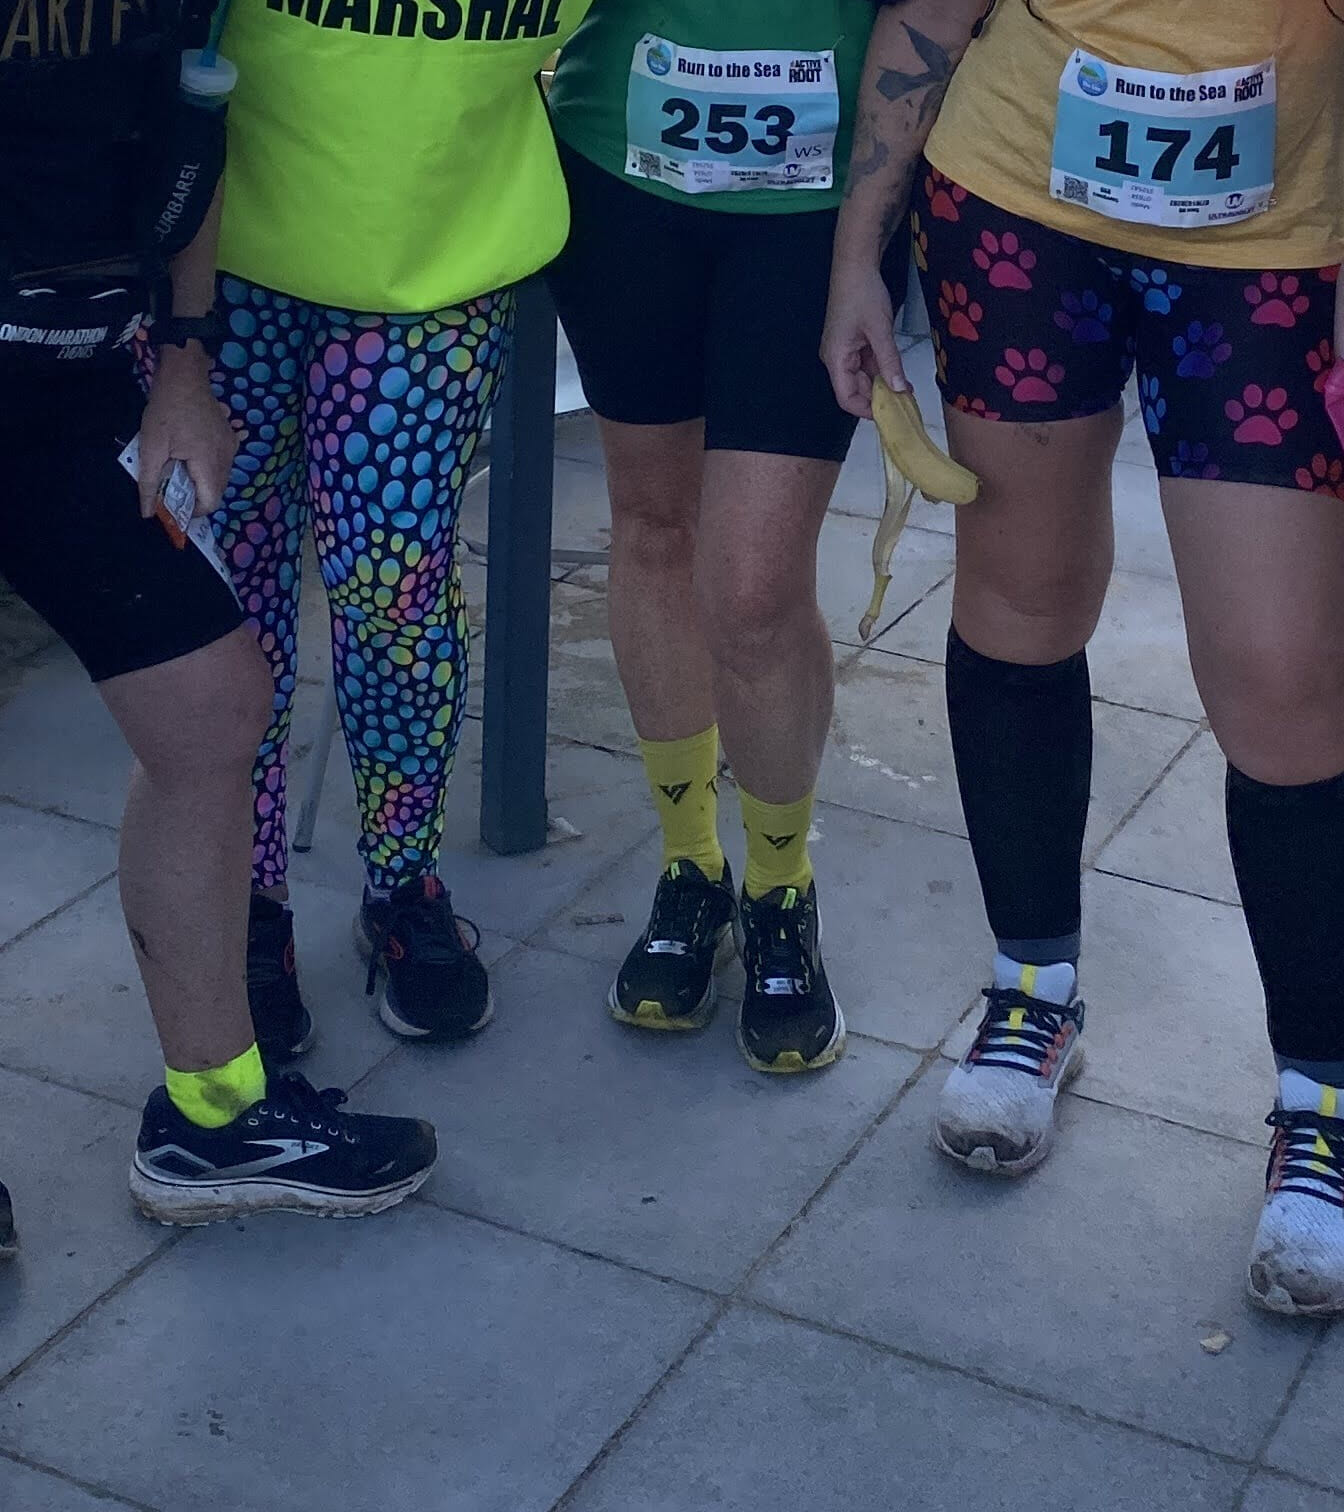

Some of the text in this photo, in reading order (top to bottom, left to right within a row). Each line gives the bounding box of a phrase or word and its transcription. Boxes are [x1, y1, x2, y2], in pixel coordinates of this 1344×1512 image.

[677, 57, 781, 78] Run to the Sea
[789, 69, 822, 83] ROOT
[1115, 78, 1146, 97] Run
[1149, 85, 1165, 100] to
[1169, 86, 1196, 102] the
[1199, 85, 1227, 101] Sea
[1234, 82, 1264, 102] ROOT
[661, 97, 796, 155] 253
[1095, 120, 1240, 181] 174
[46, 326, 109, 346] MARATHON
